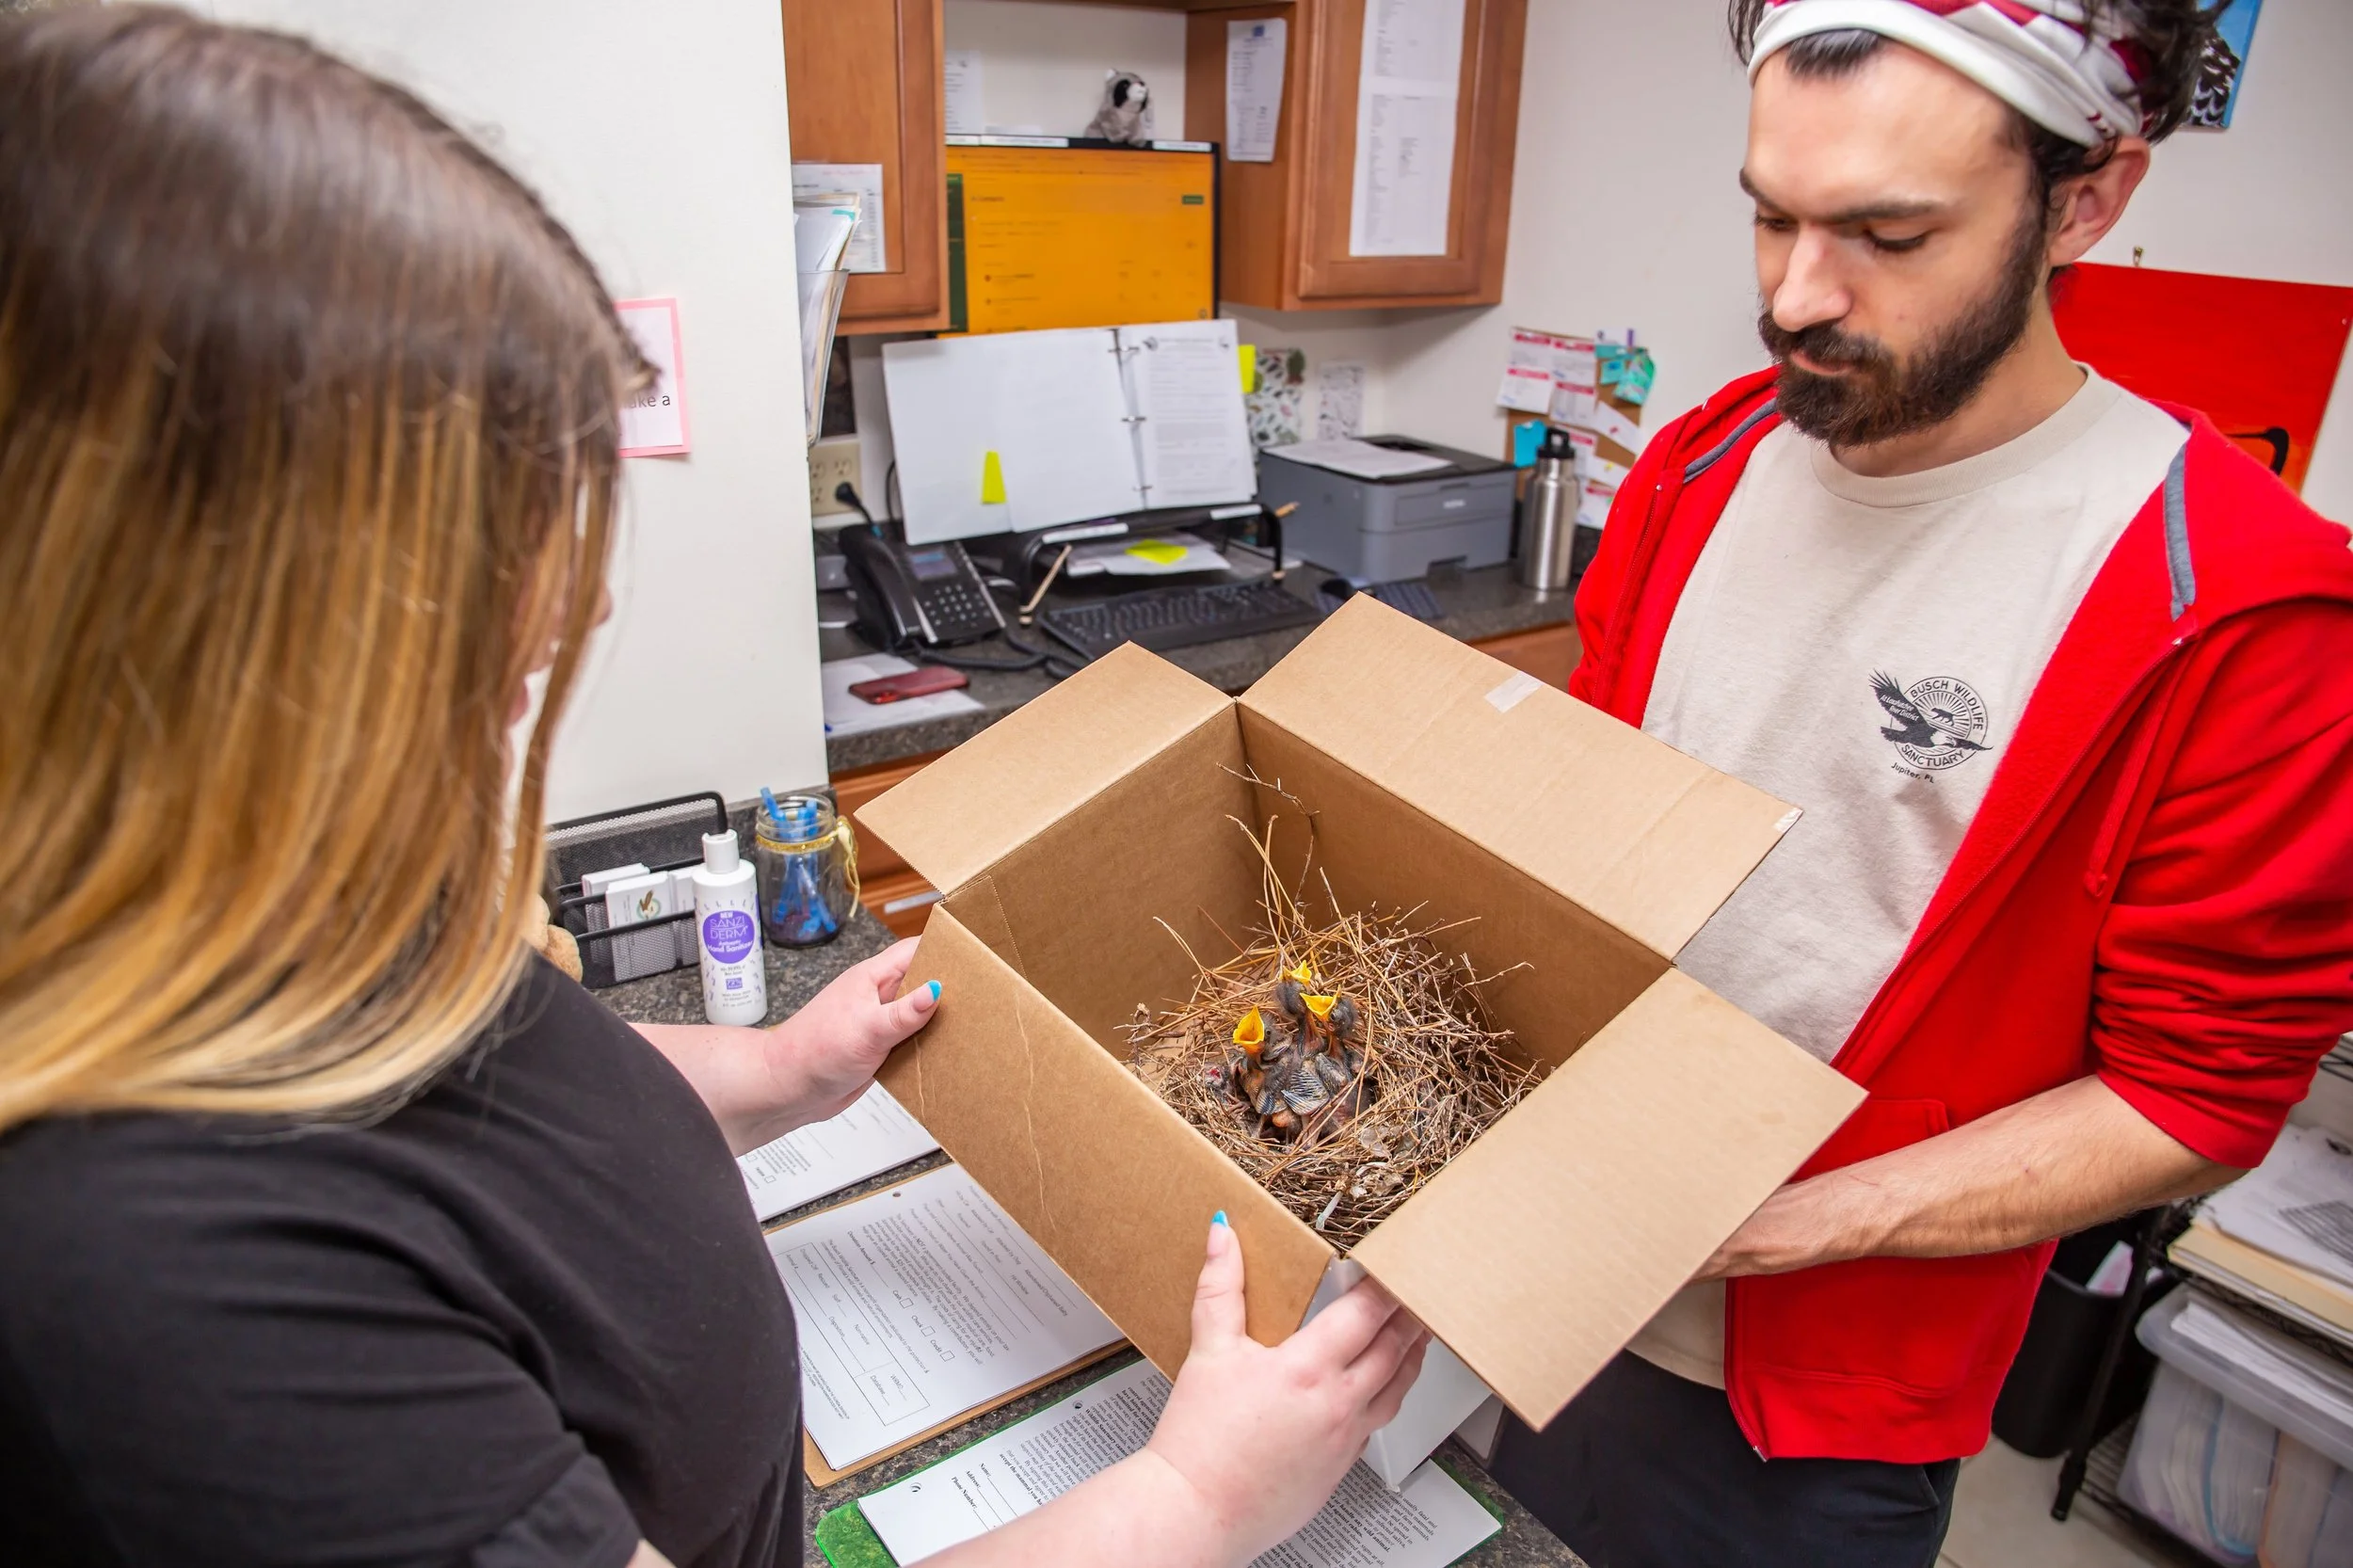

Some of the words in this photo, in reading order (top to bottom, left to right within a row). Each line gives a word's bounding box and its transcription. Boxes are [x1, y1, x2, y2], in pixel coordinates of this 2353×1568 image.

[625, 394, 656, 408] ake
[662, 395, 671, 407] a
[1911, 680, 1949, 697] BUSCH
[1954, 683, 1984, 730] WILDLIFE
[1899, 709, 1919, 721] District
[1901, 744, 1964, 767] SANCTUARY
[1891, 762, 1921, 780] Jupiter,
[1924, 774, 1935, 784] FL
[710, 915, 745, 928] SANZI
[710, 926, 746, 940] DERM
[726, 941, 753, 952] Sanitizer
[1084, 1408, 1100, 1424] Wildlife
[1096, 1423, 1117, 1444] Sanctuary
[1114, 1442, 1128, 1457] cannot
[965, 1470, 982, 1488] Address:
[978, 1463, 992, 1477] Name:
[1015, 1471, 1032, 1492] mammal
[951, 1476, 964, 1490] Phone
[960, 1489, 978, 1509] Number:
[1331, 1507, 1350, 1524] against
[1338, 1503, 1356, 1519] handle
[1362, 1525, 1375, 1537] wild
[1371, 1534, 1392, 1553] animal.
[1391, 1525, 1409, 1541] spread
[1398, 1521, 1410, 1532] even
[1411, 1523, 1431, 1541] animals
[1311, 1536, 1333, 1557] paralysis
